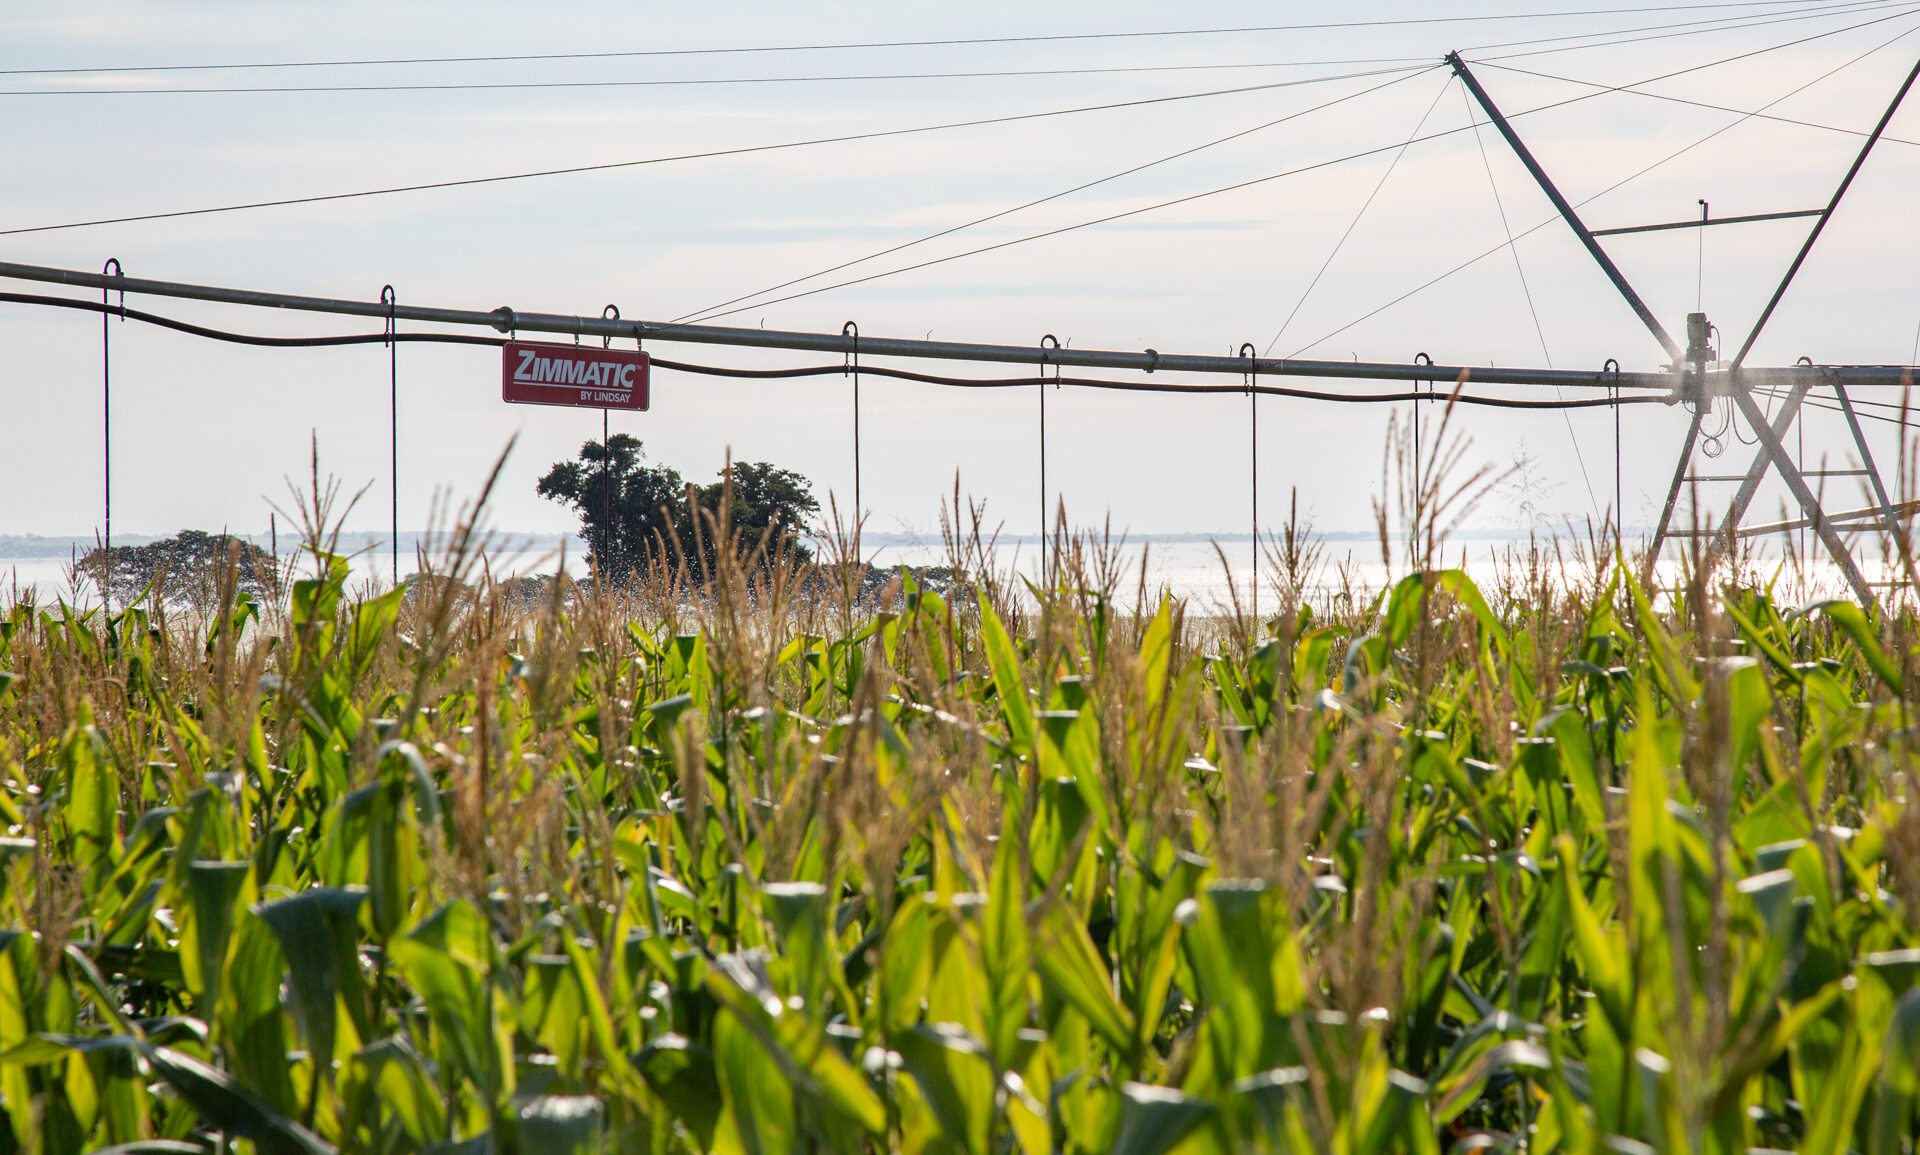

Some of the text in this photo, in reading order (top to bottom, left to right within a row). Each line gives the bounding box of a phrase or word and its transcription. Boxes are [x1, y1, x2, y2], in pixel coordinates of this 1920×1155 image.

[514, 350, 636, 388] ZIMMATIC
[580, 391, 631, 403] BY LINDSAY
